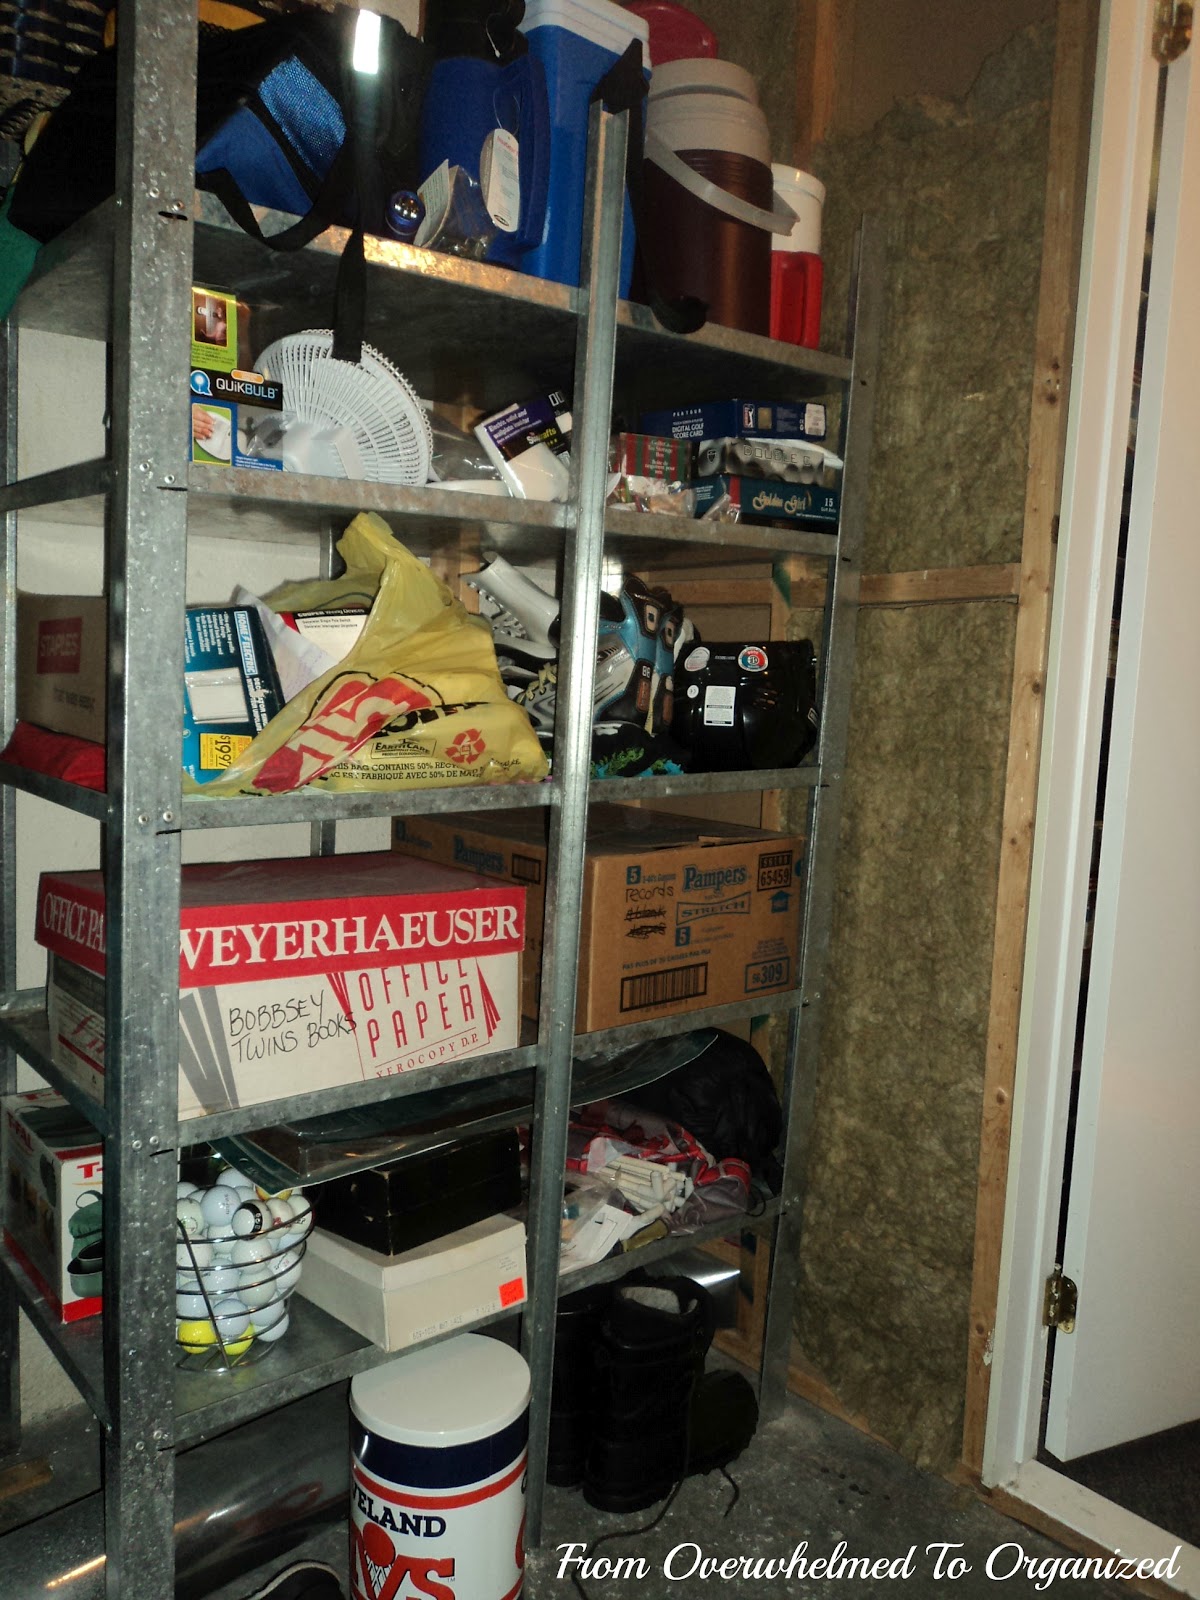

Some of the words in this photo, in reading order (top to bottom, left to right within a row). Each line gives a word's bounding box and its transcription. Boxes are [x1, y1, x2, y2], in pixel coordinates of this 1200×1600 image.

[672, 425, 690, 433] DIGITAL
[744, 445, 798, 464] DOUBLE
[752, 490, 784, 510] Golden
[784, 495, 806, 514] Girl
[824, 498, 834, 507] 15
[237, 613, 248, 634] HOME
[40, 632, 79, 656] STAPLES
[242, 641, 256, 674] ELECTRIC
[253, 678, 266, 712] DECATOR
[334, 762, 349, 770] HIS
[351, 763, 370, 771] BAG
[372, 763, 414, 771] CONTAINS
[417, 762, 433, 770] 50%
[446, 770, 458, 778] DE
[682, 864, 748, 892] Pampers
[760, 867, 790, 888] 65459
[626, 883, 674, 903] records
[682, 900, 745, 918] STRETCH
[42, 892, 86, 945] OFFICE
[87, 910, 106, 953] PA
[180, 905, 520, 970] WEYERHAEUSER
[228, 989, 325, 1036] BOBBSEY
[368, 983, 476, 1058] PAPER
[232, 1032, 298, 1063] TWINS
[307, 1011, 358, 1049] BOOKS
[375, 1041, 456, 1079] XEROCOPY
